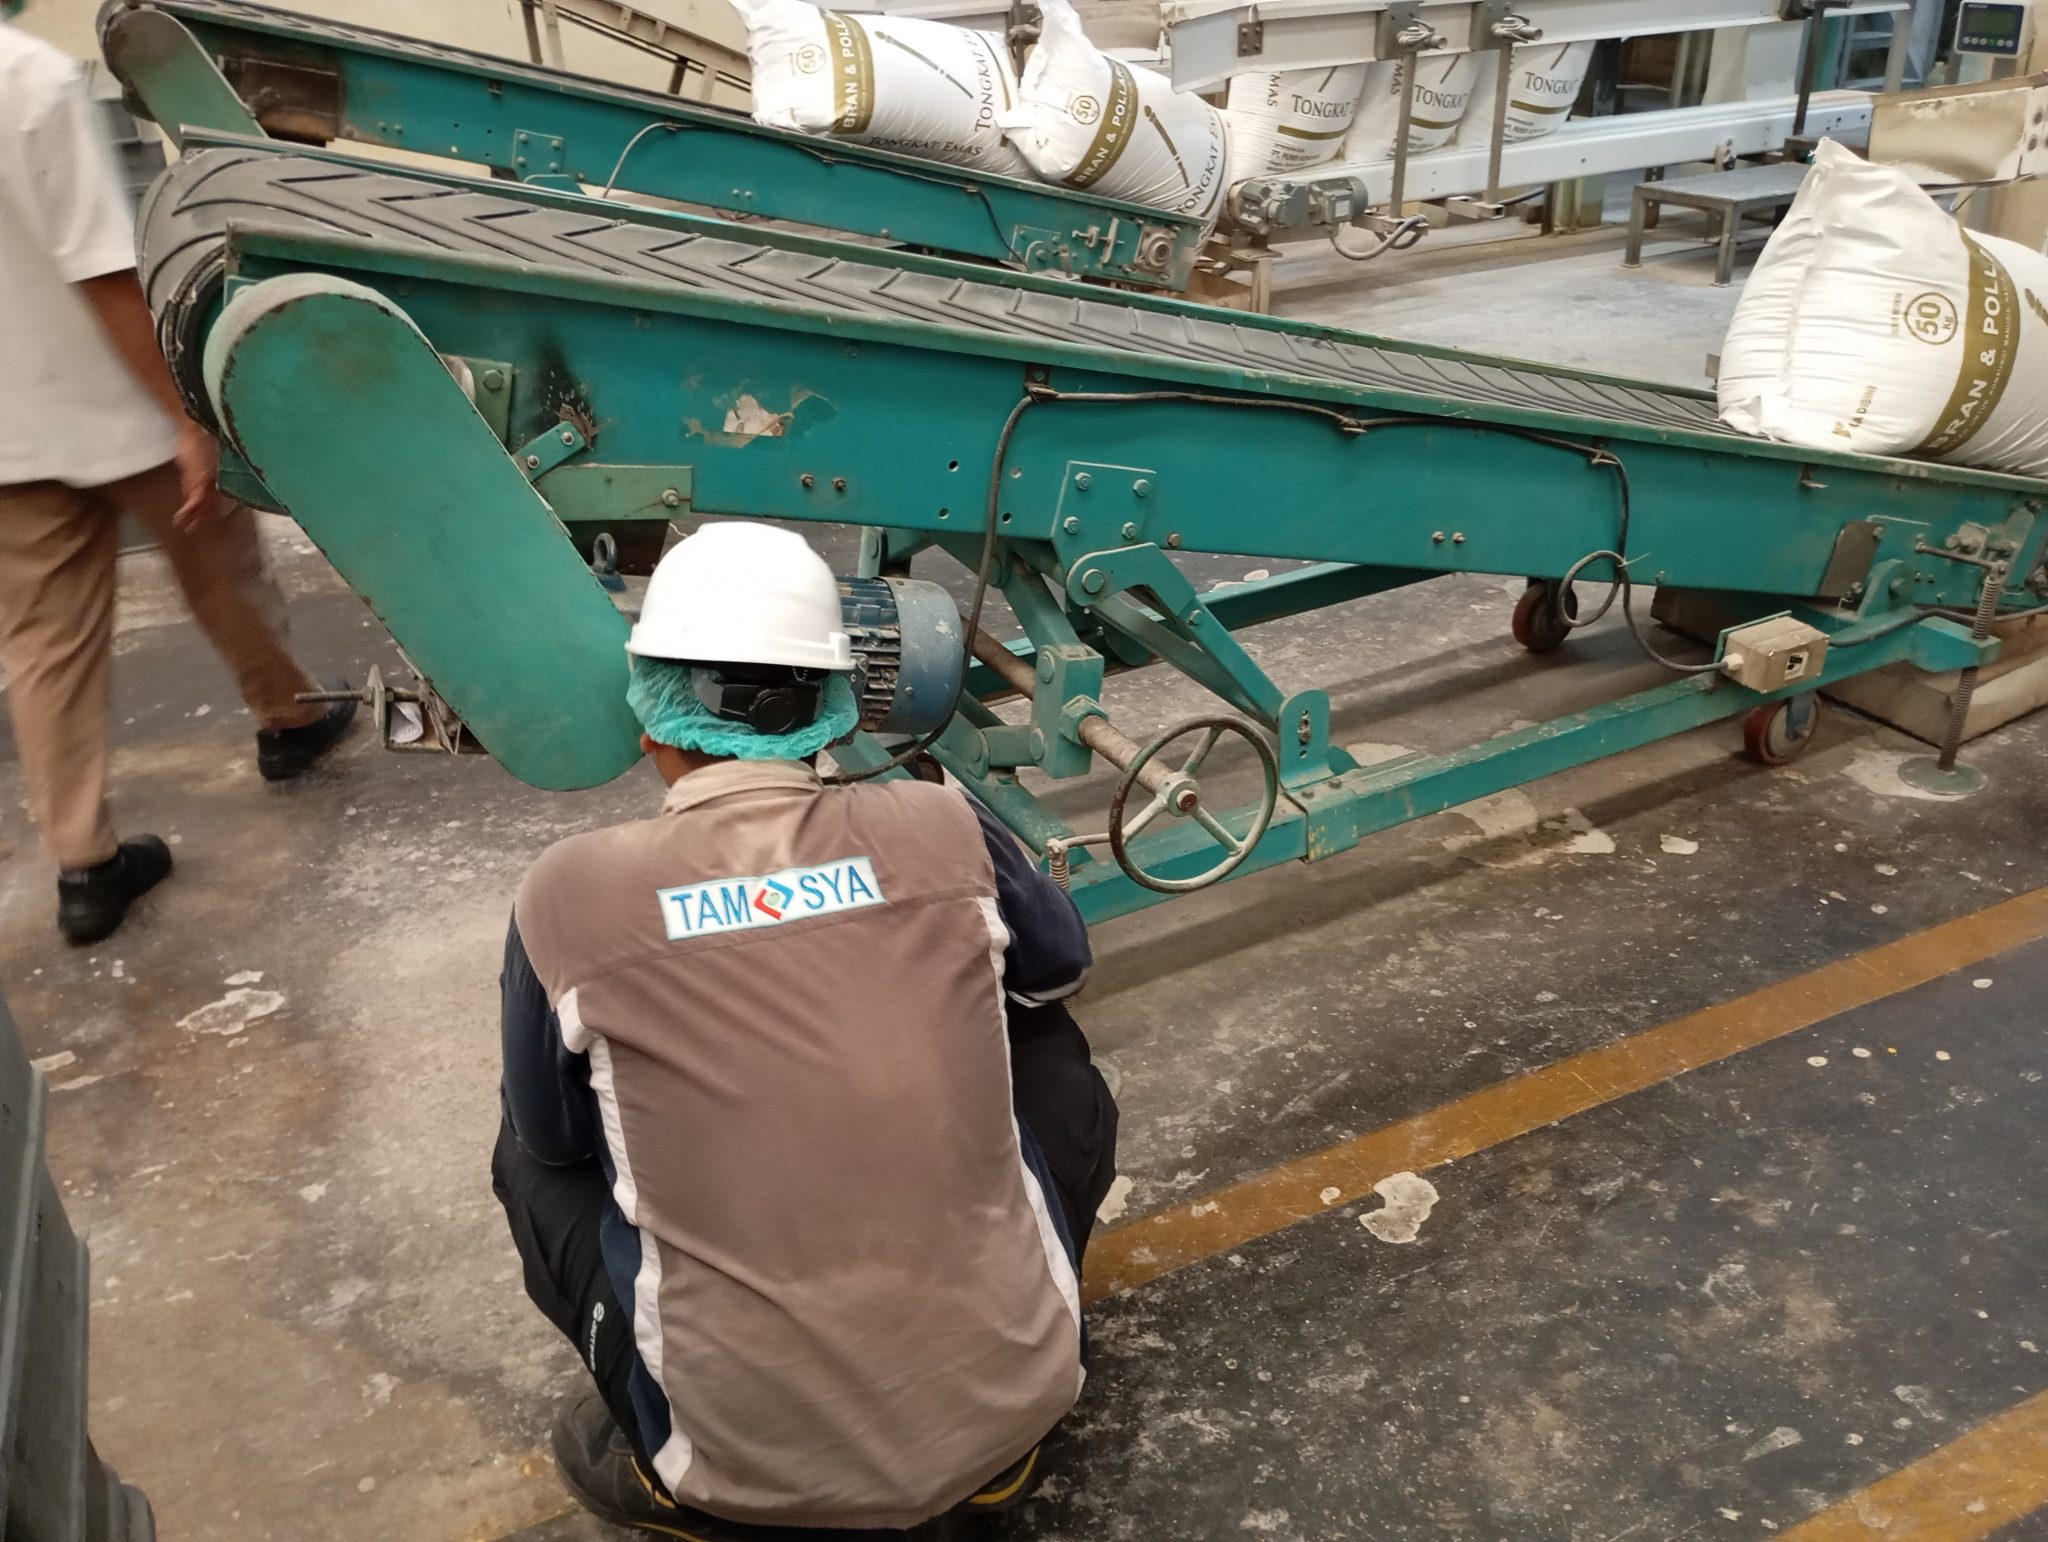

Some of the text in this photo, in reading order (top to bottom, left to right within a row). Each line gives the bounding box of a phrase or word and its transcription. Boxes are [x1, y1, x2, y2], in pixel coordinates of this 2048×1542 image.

[844, 63, 857, 75] &
[1390, 58, 1405, 96] MAS
[843, 82, 858, 128] BRAN
[966, 49, 994, 133] TONGKAT
[1267, 71, 1283, 107] MAS
[1292, 94, 1351, 118] TONGKAT
[1076, 99, 1092, 120] 50
[869, 136, 984, 156] TONGKAT EMAS
[1075, 147, 1109, 182] BRAN
[1106, 132, 1118, 143] &
[1173, 145, 1219, 213] TONGKAT
[1916, 302, 1941, 336] 50
[1980, 348, 1996, 367] &
